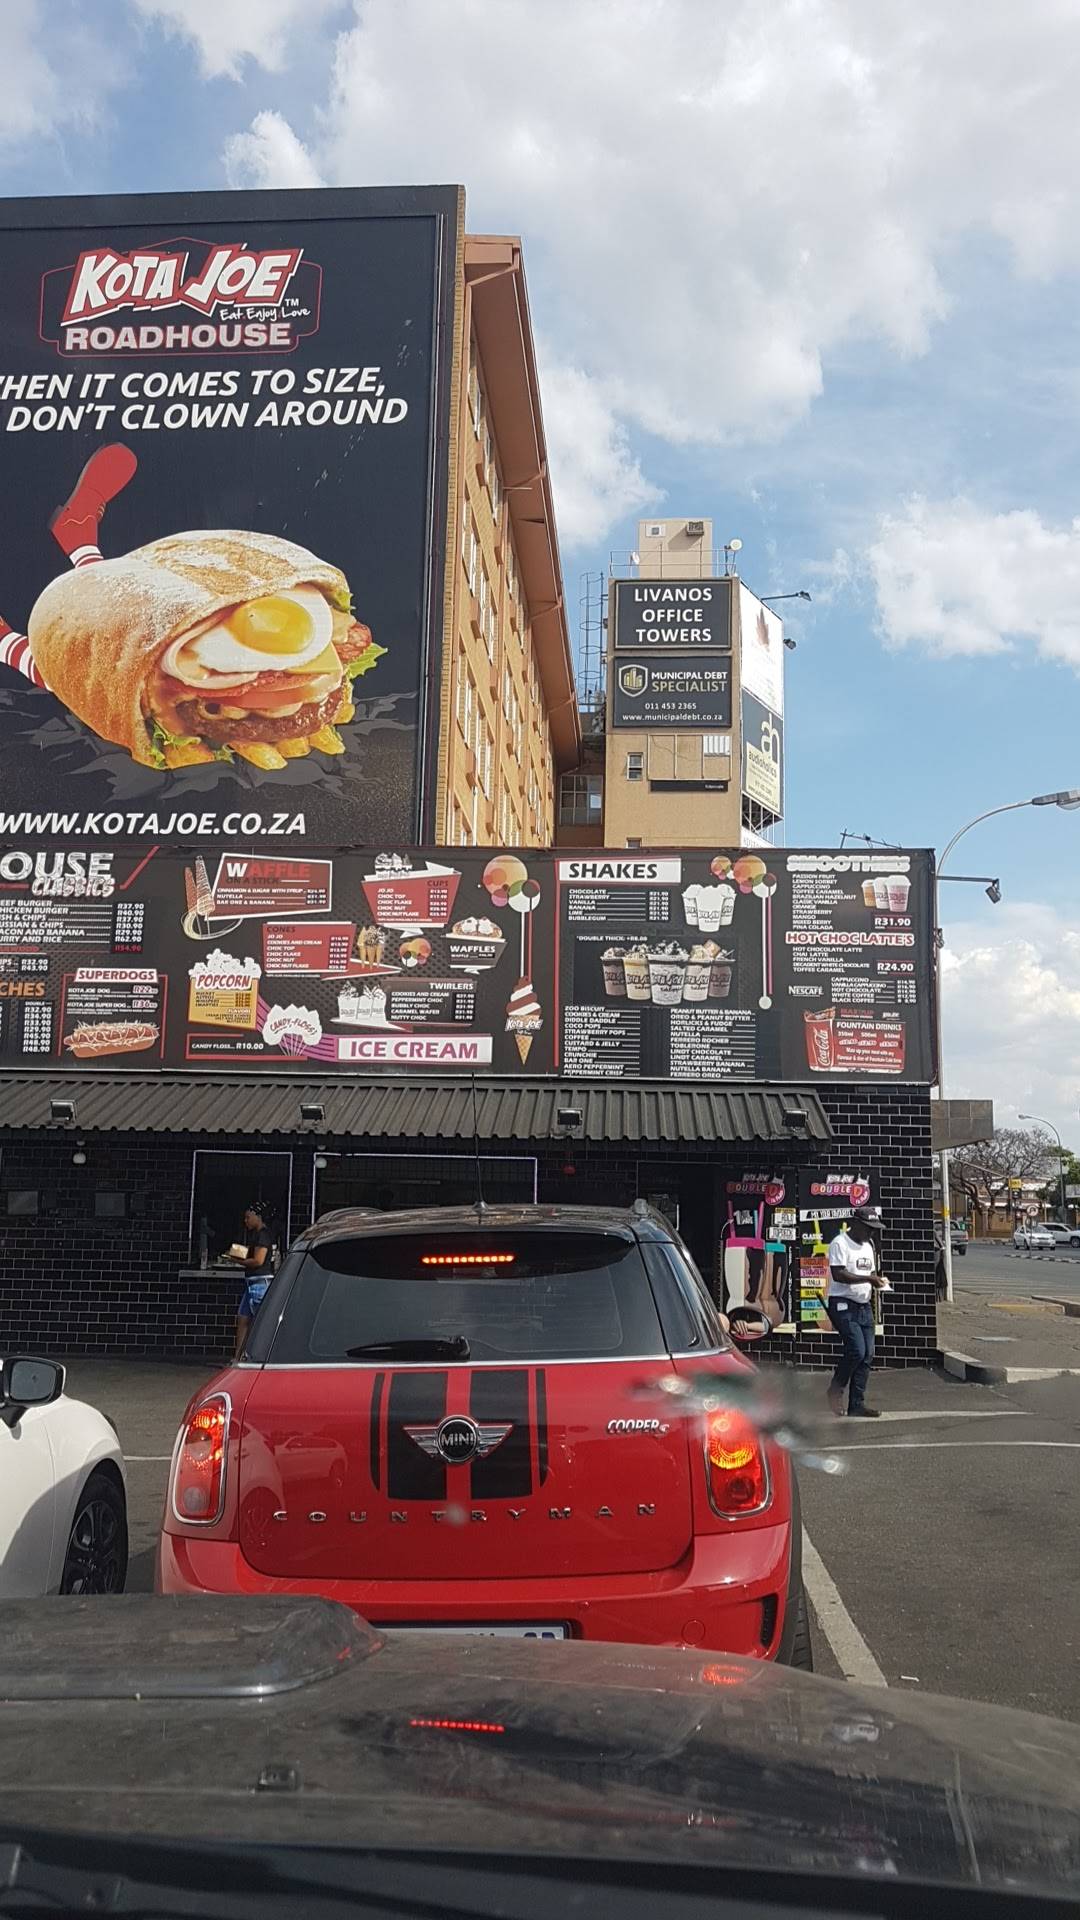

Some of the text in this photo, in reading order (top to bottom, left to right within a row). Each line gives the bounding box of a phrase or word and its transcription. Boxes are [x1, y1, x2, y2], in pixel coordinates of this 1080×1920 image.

[70, 247, 293, 313] KOTA JOE
[65, 323, 292, 352] ROADHOUSE
[0, 367, 386, 401] HEN IT COMES TO SIZE,
[6, 398, 408, 433] DON'T CLOWN AROUND
[634, 587, 713, 602] LIVANOS
[641, 608, 704, 623] OFFICE
[635, 628, 712, 643] TOWERS
[651, 671, 728, 680] MUNICIPAL DEBT
[651, 681, 728, 693] SPECIALIST
[645, 702, 697, 710] 011 453 2365
[622, 713, 723, 722] www.municipaldebt.co.za
[0, 812, 306, 835] WWW.KOTAJOE.CO.ZA
[226, 862, 311, 878] WAFFLE
[568, 862, 658, 879] SHAKES
[874, 917, 911, 926] R31.90
[786, 932, 819, 944] HOT
[819, 932, 860, 944] CHOC
[450, 945, 495, 953] WAFFLES
[877, 962, 914, 972] R24.90
[78, 970, 155, 980] SUPERDOGS
[196, 973, 251, 988] POPCORN
[429, 982, 474, 990] TWIRLERS
[836, 1021, 902, 1030] FOUNTAIN DRINKS
[351, 1040, 478, 1059] ICE CREAM
[810, 1183, 852, 1196] DOUBLE
[607, 1418, 660, 1434] COOPER
[441, 1432, 475, 1446] MINI
[272, 1502, 657, 1524] COUNTRYMAN
